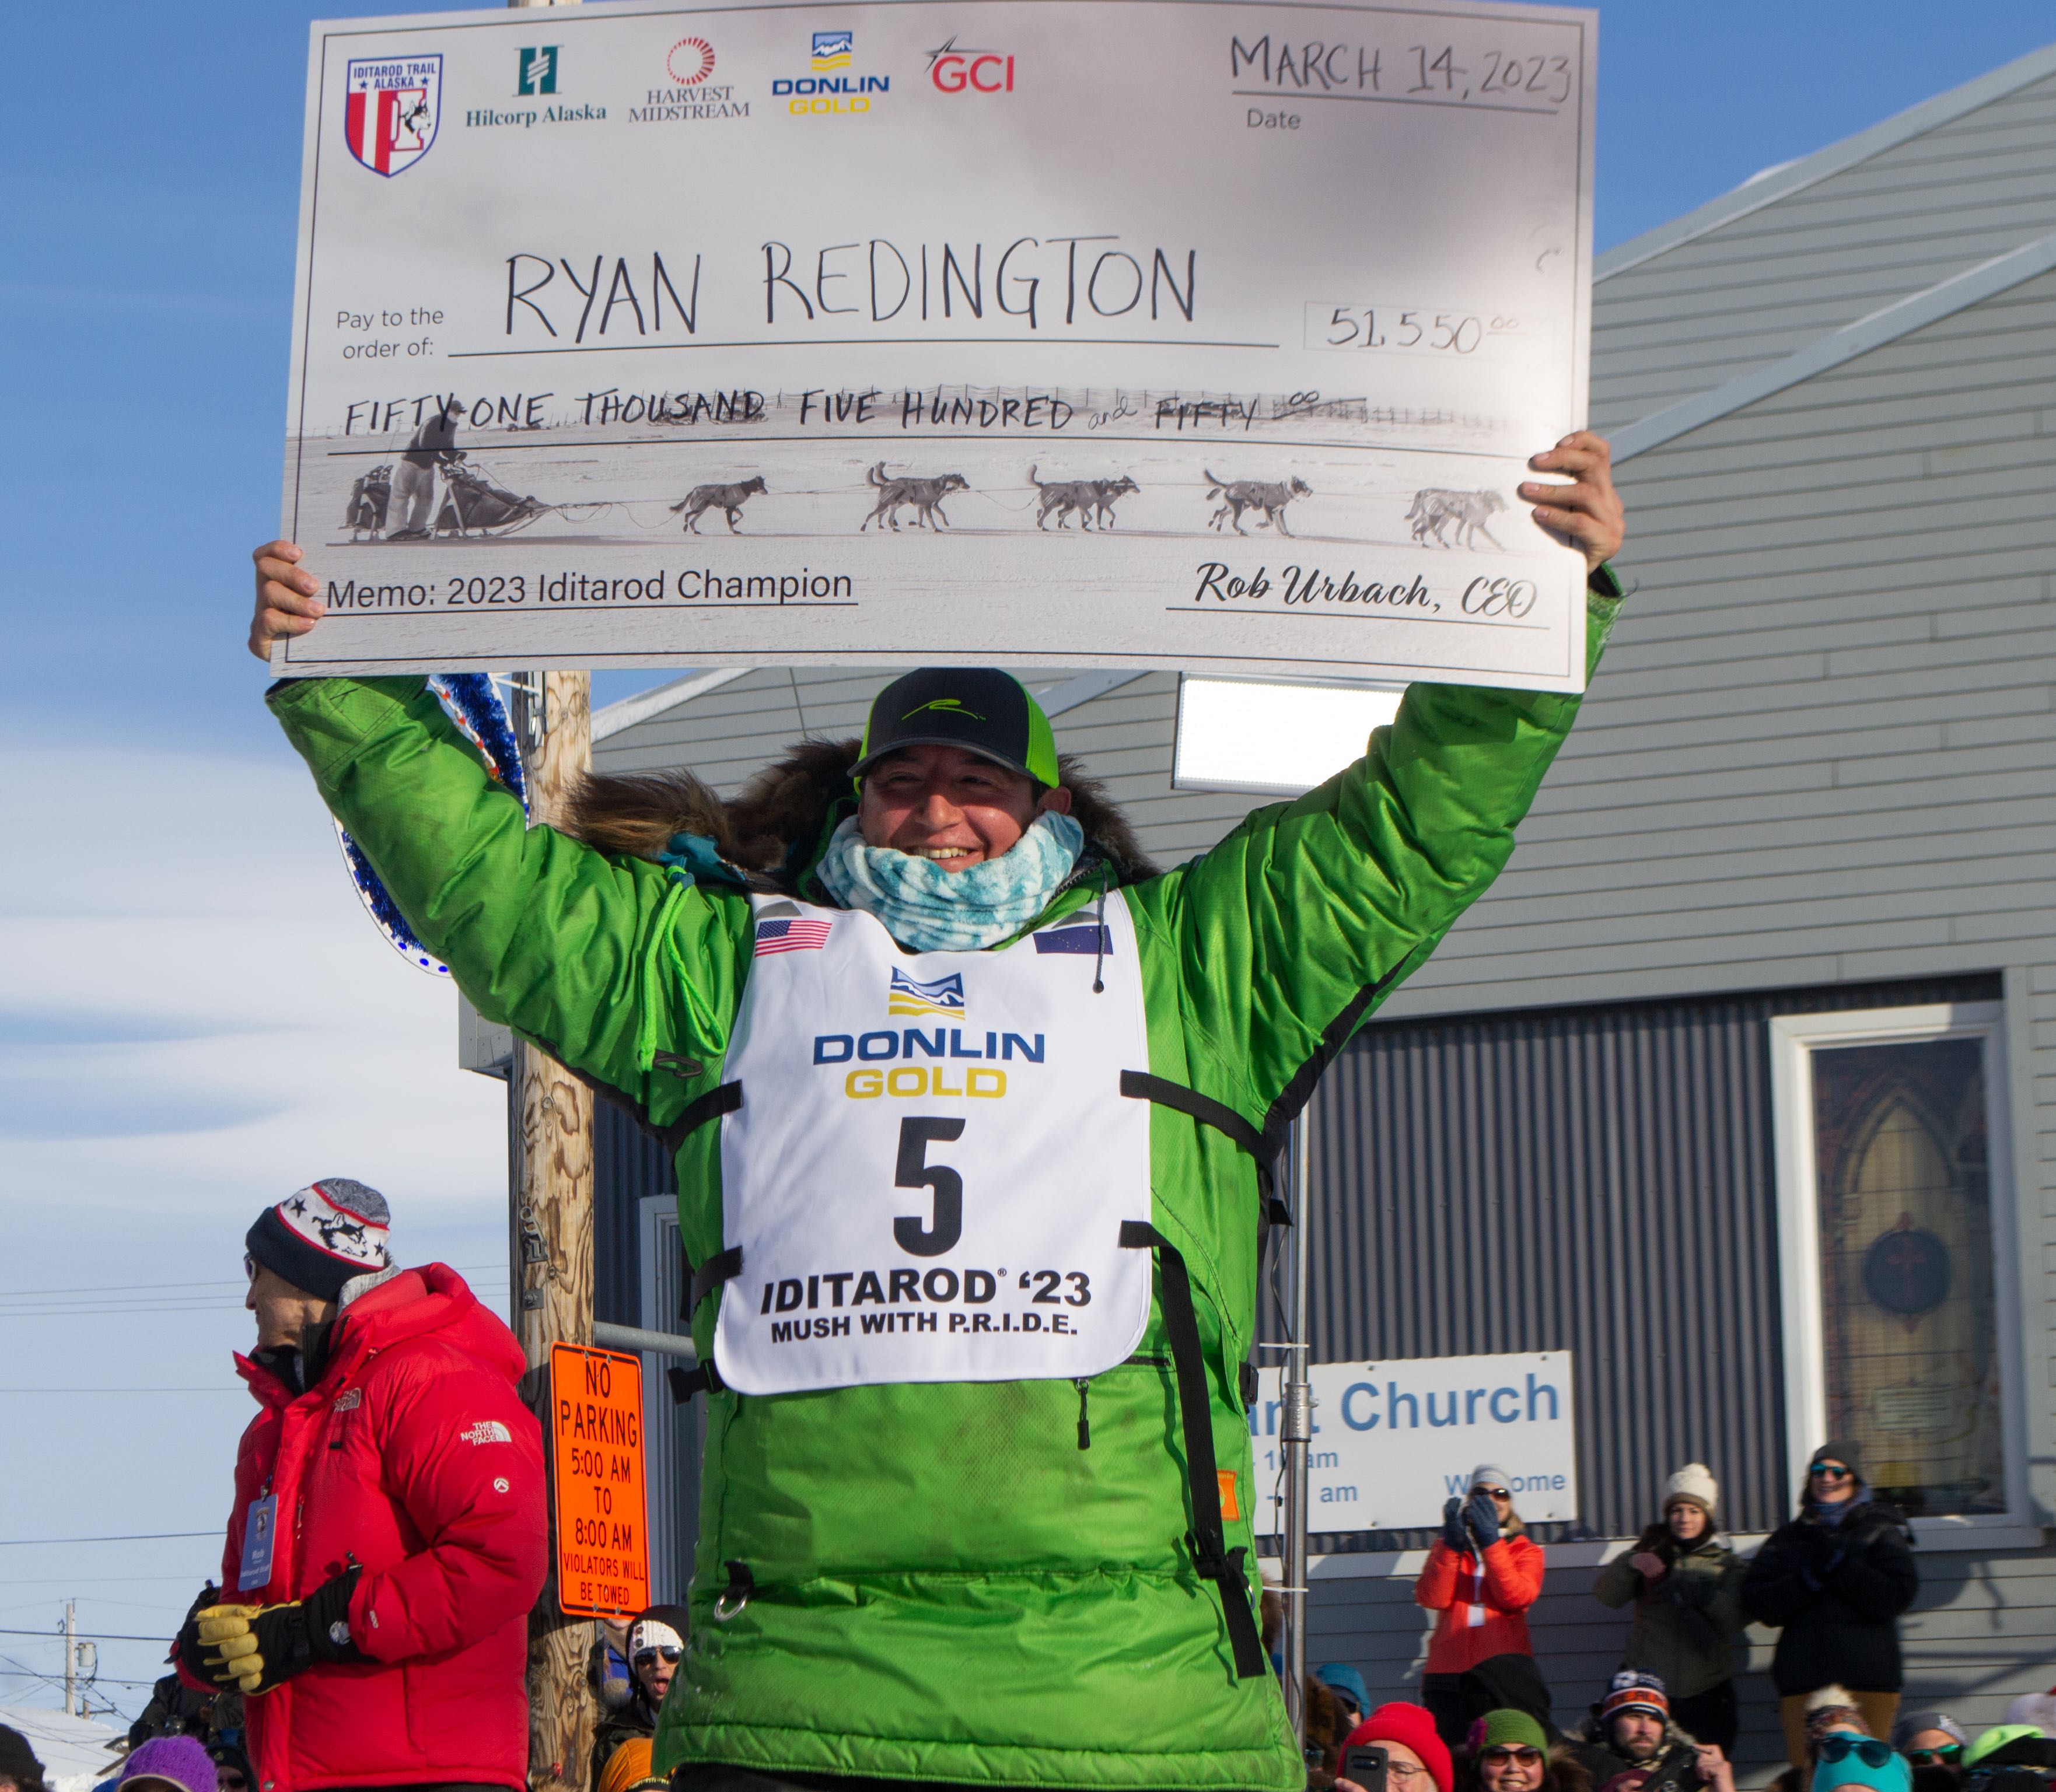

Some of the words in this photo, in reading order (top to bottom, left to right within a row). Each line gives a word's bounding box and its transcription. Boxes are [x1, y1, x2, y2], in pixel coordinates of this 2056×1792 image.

[354, 64, 403, 79] IDITAROD
[407, 62, 436, 76] TRAIL
[932, 55, 1015, 93] GCI
[1231, 34, 1382, 91] MARCH
[374, 76, 415, 90] ALASKA
[646, 85, 735, 105] HARVEST
[772, 76, 890, 96] DONLIN
[466, 108, 537, 129] Hilcorp
[543, 104, 607, 123] Alaska
[628, 102, 750, 123] MIDSTREAM
[789, 97, 870, 116] GOLD
[1246, 107, 1302, 130] Date
[506, 251, 701, 344] RYAN
[761, 236, 1196, 329] REDINGTON
[337, 310, 374, 330] Pay
[382, 310, 403, 327] to
[410, 307, 444, 326] the
[343, 340, 400, 359] order
[407, 337, 433, 356] of:
[345, 393, 454, 436] FIFTY
[470, 393, 554, 427] ONE
[576, 388, 765, 426] THOUSAND
[800, 389, 882, 426] FIVE
[901, 393, 1074, 430] HUNDRED
[1088, 396, 1138, 430] and
[1156, 397, 1257, 431] FIFTY
[327, 580, 435, 608] Memo:
[447, 576, 526, 604] 2023
[539, 569, 665, 603] Iditarod
[678, 568, 852, 604] Champion
[1195, 562, 1273, 602] Rob
[1282, 565, 1441, 613] Urbach,
[1461, 575, 1537, 618] CEO
[813, 1028, 1045, 1066] DONLIN
[845, 1066, 1008, 1100] GOLD
[893, 1116, 966, 1257] 5
[771, 1315, 851, 1343] MUSH
[861, 1312, 938, 1335] WITH
[949, 1312, 1078, 1335] P.R.I.D.E.
[586, 1360, 611, 1398] NO
[1340, 1372, 1560, 1432] Church
[460, 1427, 495, 1441] NORTH
[472, 1421, 492, 1430] THE
[560, 1399, 637, 1448] PARKING
[472, 1434, 496, 1446] FACE
[571, 1447, 603, 1478] 5:00
[611, 1454, 631, 1483] AM
[1445, 1474, 1566, 1495] Wome
[594, 1486, 612, 1515] TO
[575, 1517, 607, 1548] 8:00
[611, 1522, 632, 1552] AM
[563, 1552, 618, 1577] VIOLATORS
[623, 1560, 645, 1581] WILL
[581, 1581, 593, 1601] BE
[597, 1584, 630, 1605] TOWED
